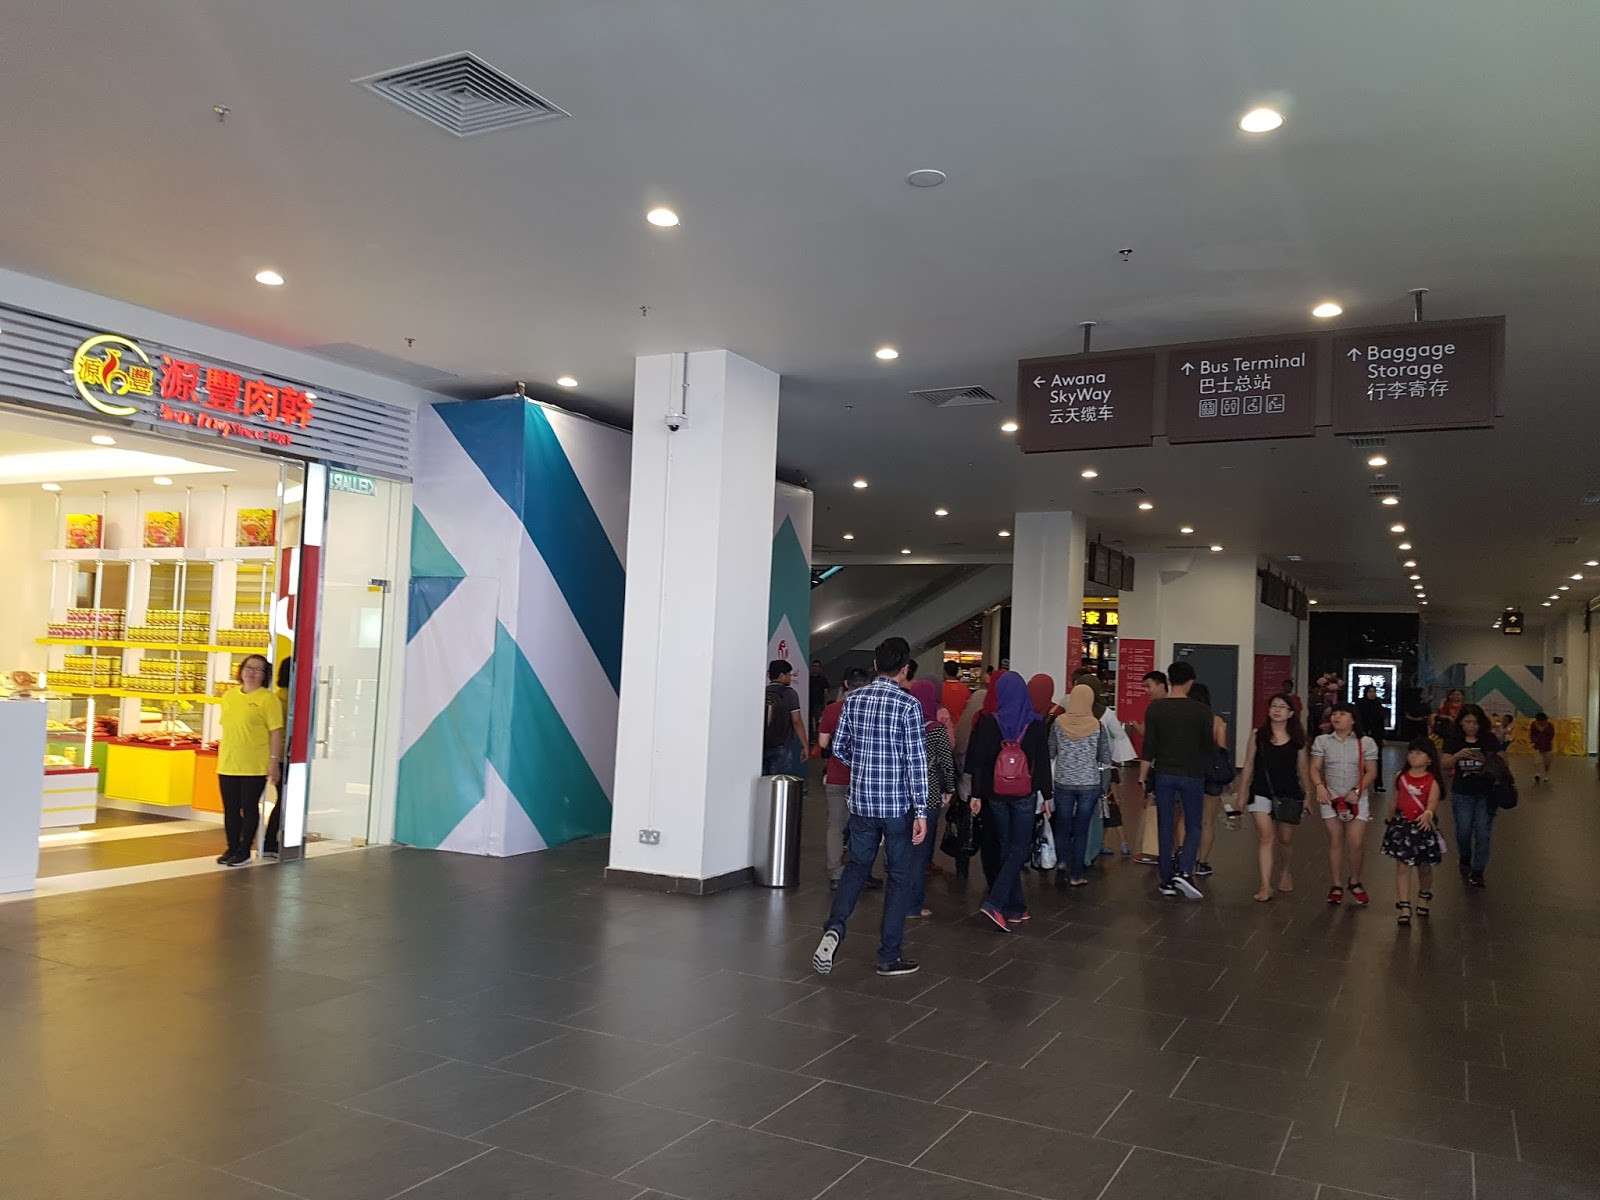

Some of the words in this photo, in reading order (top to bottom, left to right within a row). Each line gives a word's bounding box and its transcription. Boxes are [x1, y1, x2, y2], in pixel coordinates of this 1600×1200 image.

[1200, 360, 1229, 374] Bus
[1233, 352, 1306, 372] Terminal
[1367, 343, 1456, 363] Baggage
[1050, 373, 1106, 388] Awana
[1367, 363, 1444, 379] Storage
[1199, 373, 1272, 394] 巴士总站
[1367, 378, 1449, 401] 行李寄存
[1049, 387, 1112, 406] SkyWay
[1048, 404, 1114, 424] 云天缆车
